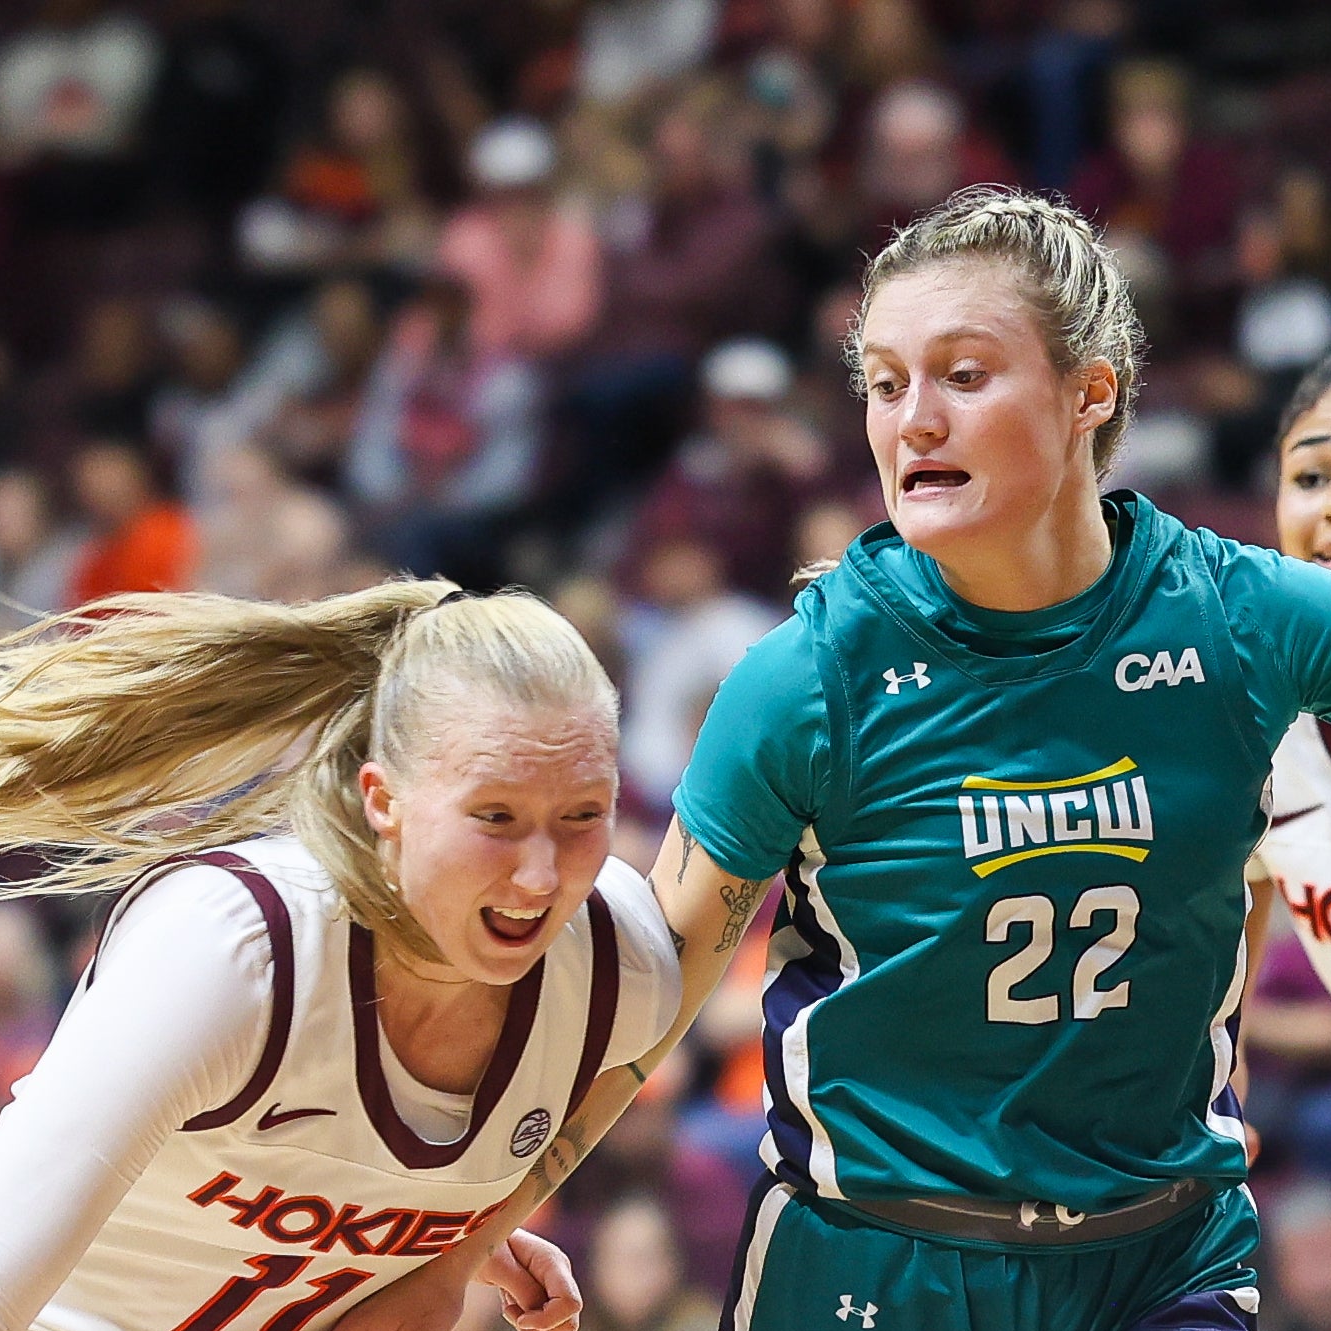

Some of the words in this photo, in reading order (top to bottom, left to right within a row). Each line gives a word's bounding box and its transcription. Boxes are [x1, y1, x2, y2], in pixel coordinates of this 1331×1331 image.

[1114, 647, 1206, 693] CAA
[957, 775, 1154, 859] UNCW
[983, 884, 1142, 1026] 22
